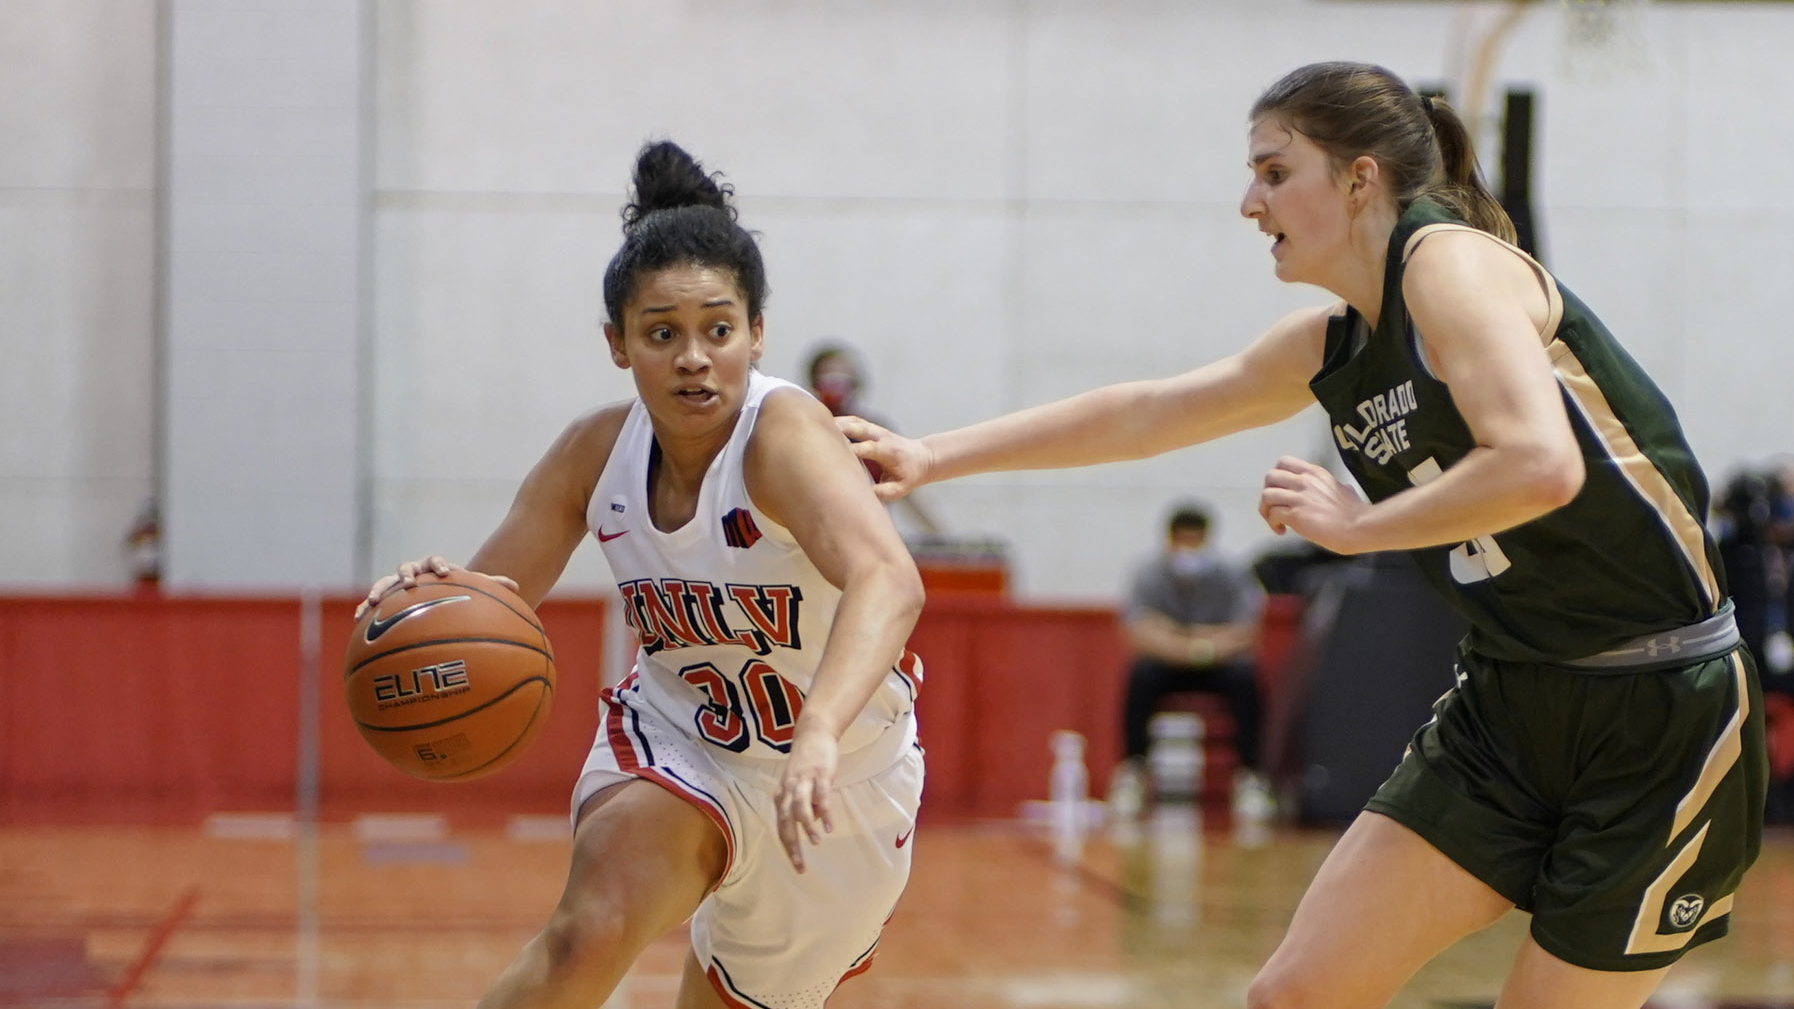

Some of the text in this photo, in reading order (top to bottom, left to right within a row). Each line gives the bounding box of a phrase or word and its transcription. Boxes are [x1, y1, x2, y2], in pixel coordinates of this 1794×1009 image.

[617, 577, 804, 657] UNLV
[373, 659, 470, 702] ELITE
[678, 658, 806, 754] 30
